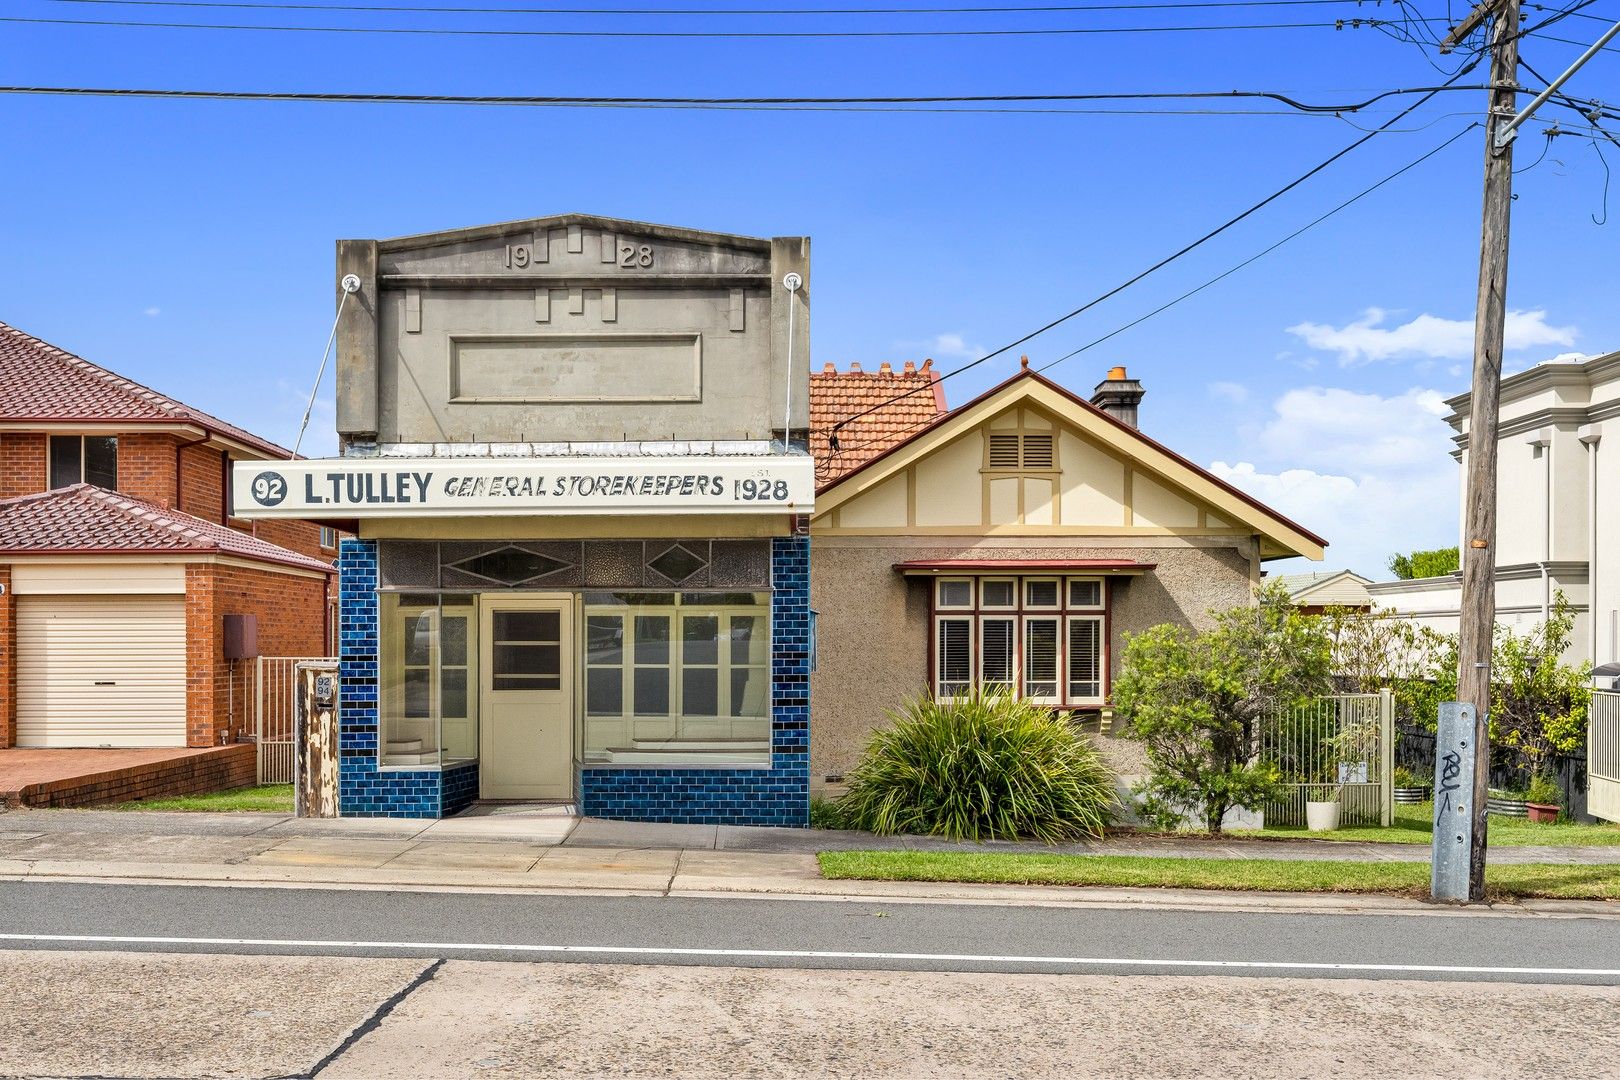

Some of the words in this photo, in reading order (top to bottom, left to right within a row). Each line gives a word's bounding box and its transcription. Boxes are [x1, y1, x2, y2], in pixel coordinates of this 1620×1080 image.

[505, 244, 529, 267] 19
[621, 246, 653, 268] 28
[255, 478, 282, 499] 92
[305, 472, 433, 503] L.TULLEY
[444, 476, 547, 497] GENERAL
[553, 475, 724, 496] STOREKEEPERS
[734, 479, 789, 501] 1928
[317, 677, 330, 686] 92
[317, 686, 330, 695] 94
